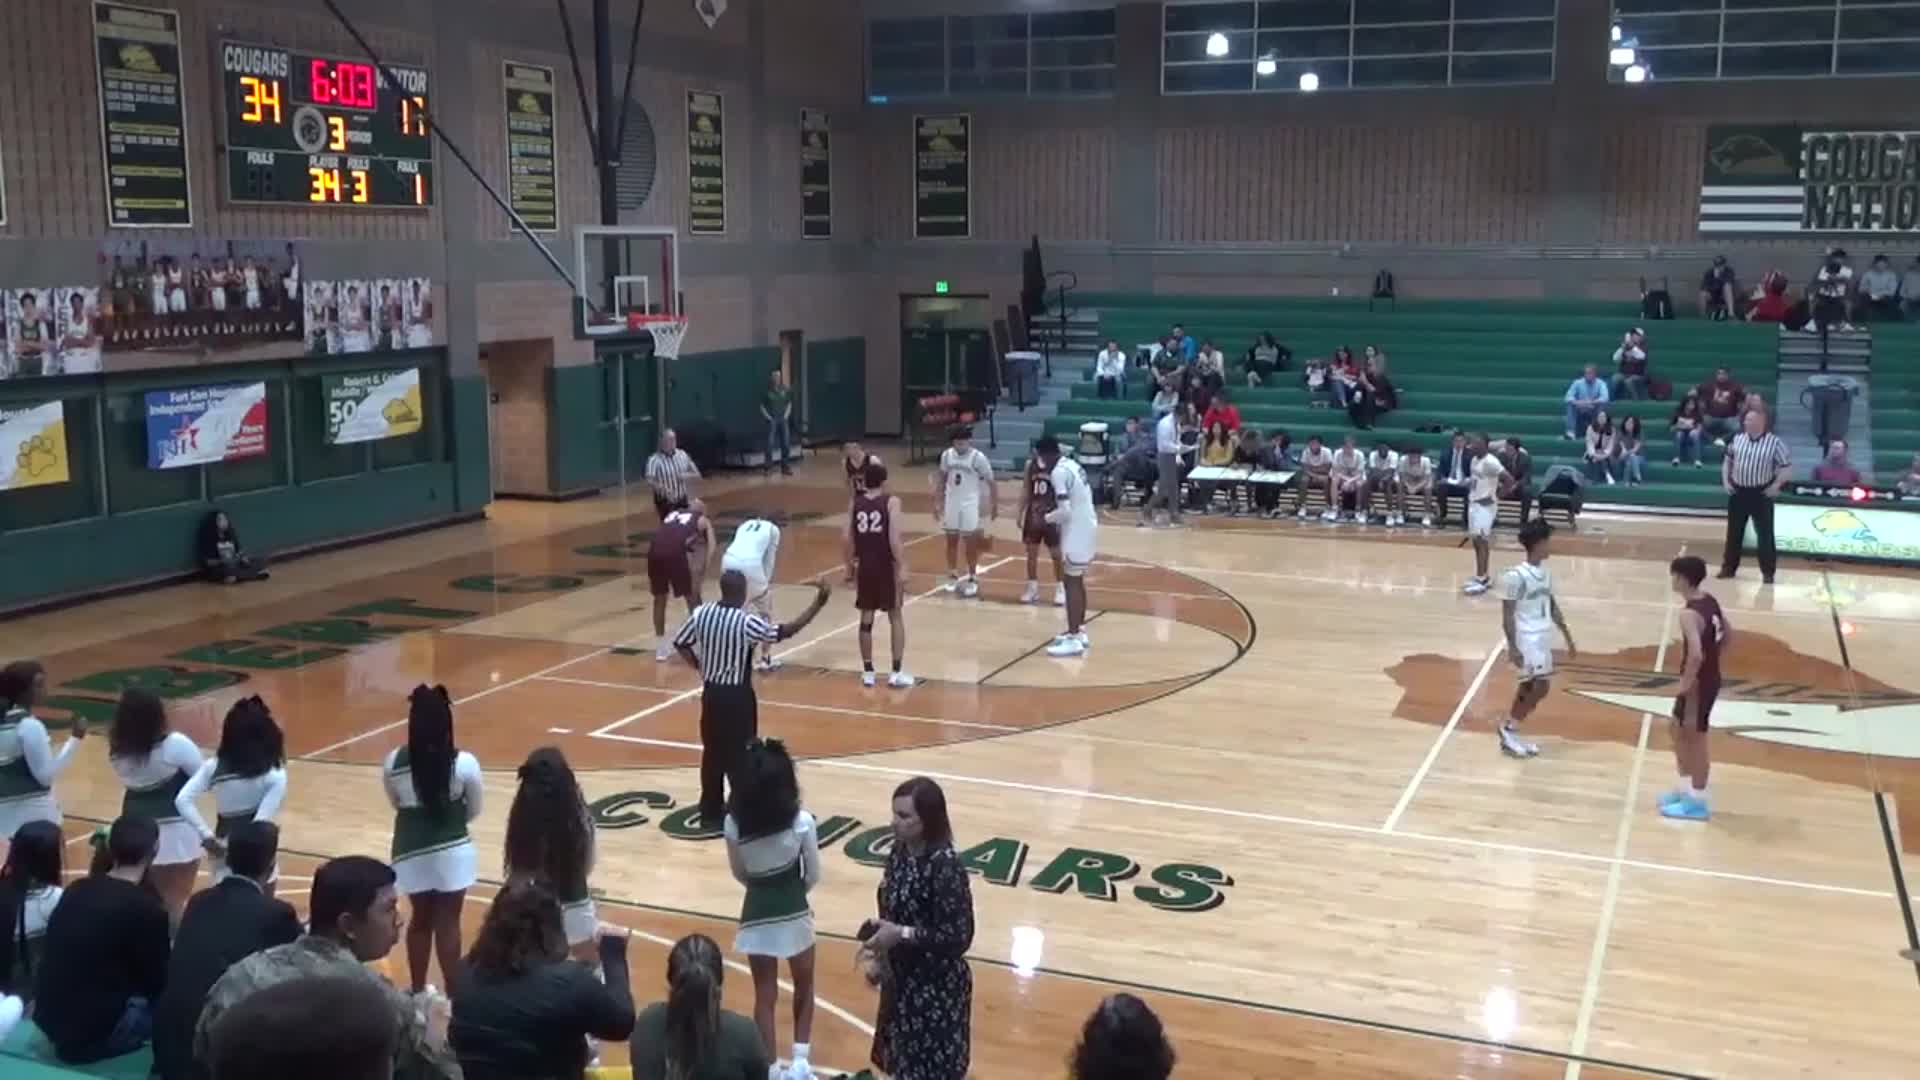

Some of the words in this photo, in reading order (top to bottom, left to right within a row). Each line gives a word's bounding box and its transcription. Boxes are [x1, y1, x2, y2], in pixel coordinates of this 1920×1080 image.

[224, 45, 288, 77] COUGARS
[311, 59, 373, 108] 6:03
[239, 77, 281, 124] 34
[328, 116, 345, 151] 3
[247, 151, 275, 166] FOULS
[309, 168, 340, 202] 34
[352, 170, 367, 203] 3
[414, 173, 423, 205] 1
[330, 400, 357, 423] 50
[1034, 481, 1048, 495] 10
[856, 509, 883, 534] 32
